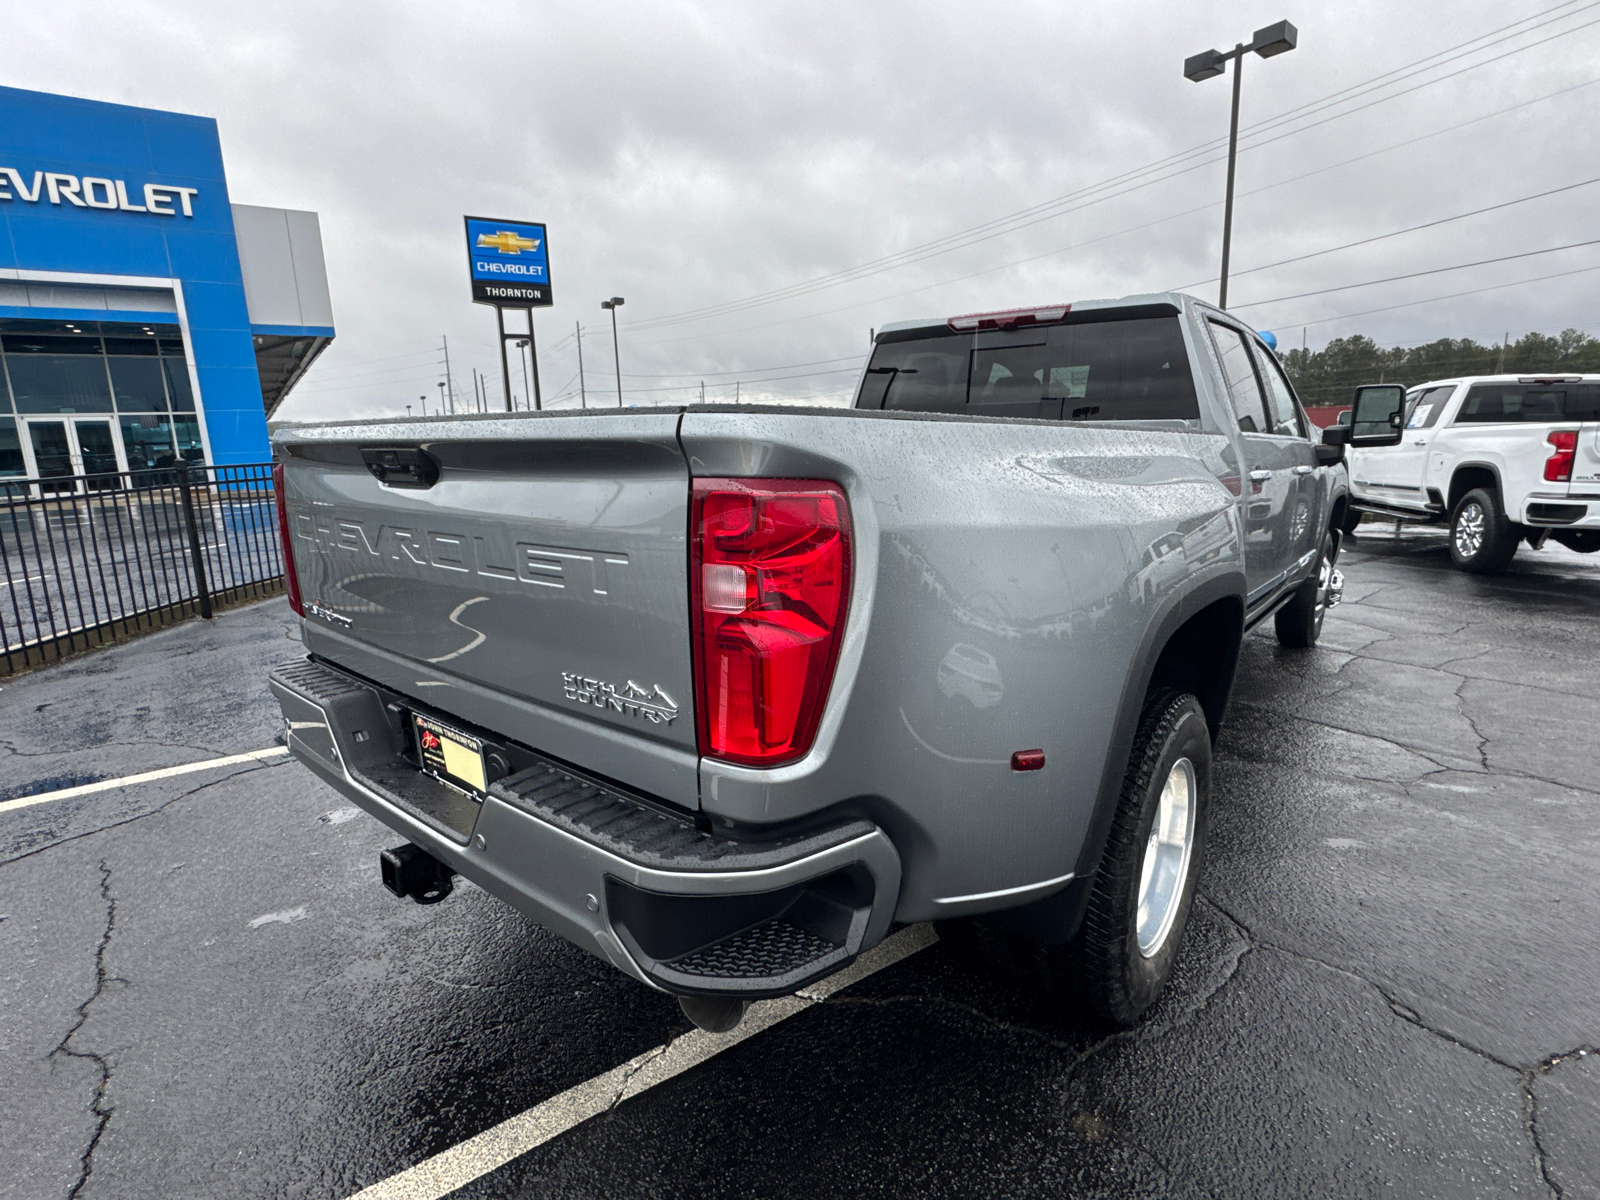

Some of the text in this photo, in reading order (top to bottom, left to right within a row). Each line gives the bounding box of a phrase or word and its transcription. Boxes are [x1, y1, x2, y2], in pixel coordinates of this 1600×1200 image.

[477, 261, 543, 276] CHEVROLET
[485, 286, 541, 299] THORNTON
[295, 510, 629, 595] CHEVROLET
[561, 671, 616, 697] HIGH
